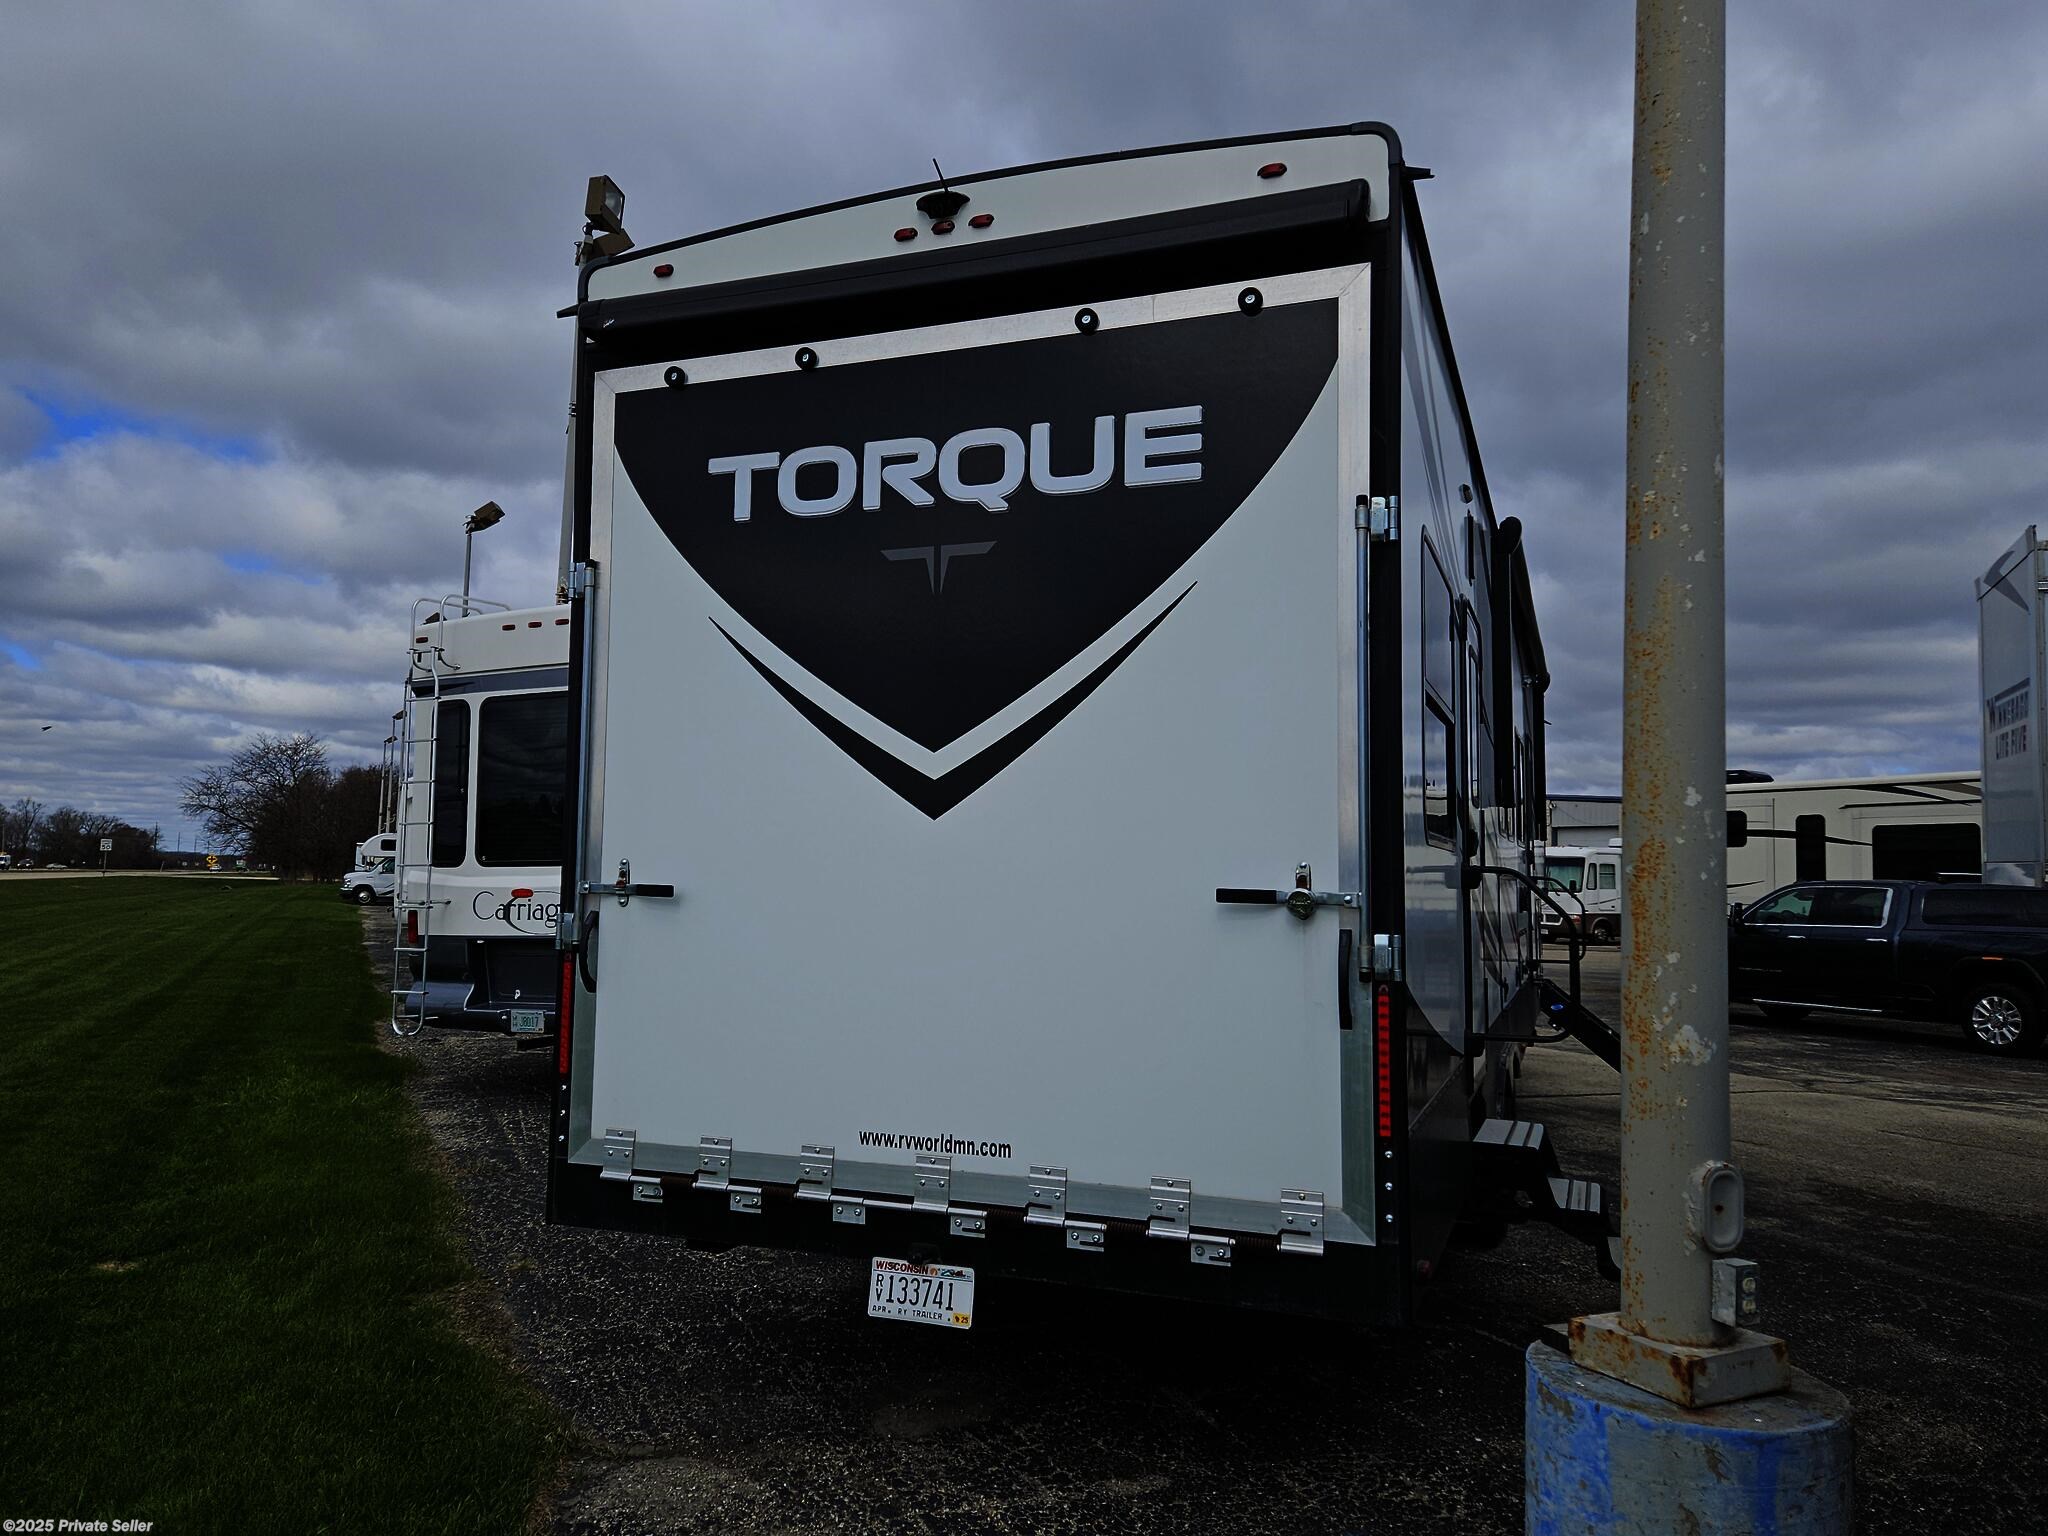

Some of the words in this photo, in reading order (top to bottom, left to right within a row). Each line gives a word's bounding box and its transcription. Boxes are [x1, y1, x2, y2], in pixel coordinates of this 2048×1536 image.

[707, 404, 1203, 522] TORQUE
[472, 890, 561, 928] Carriag
[858, 1130, 1012, 1158] www.rvworldmn.com
[875, 1260, 929, 1275] WISCONSIN
[912, 1309, 943, 1320] TRAILER
